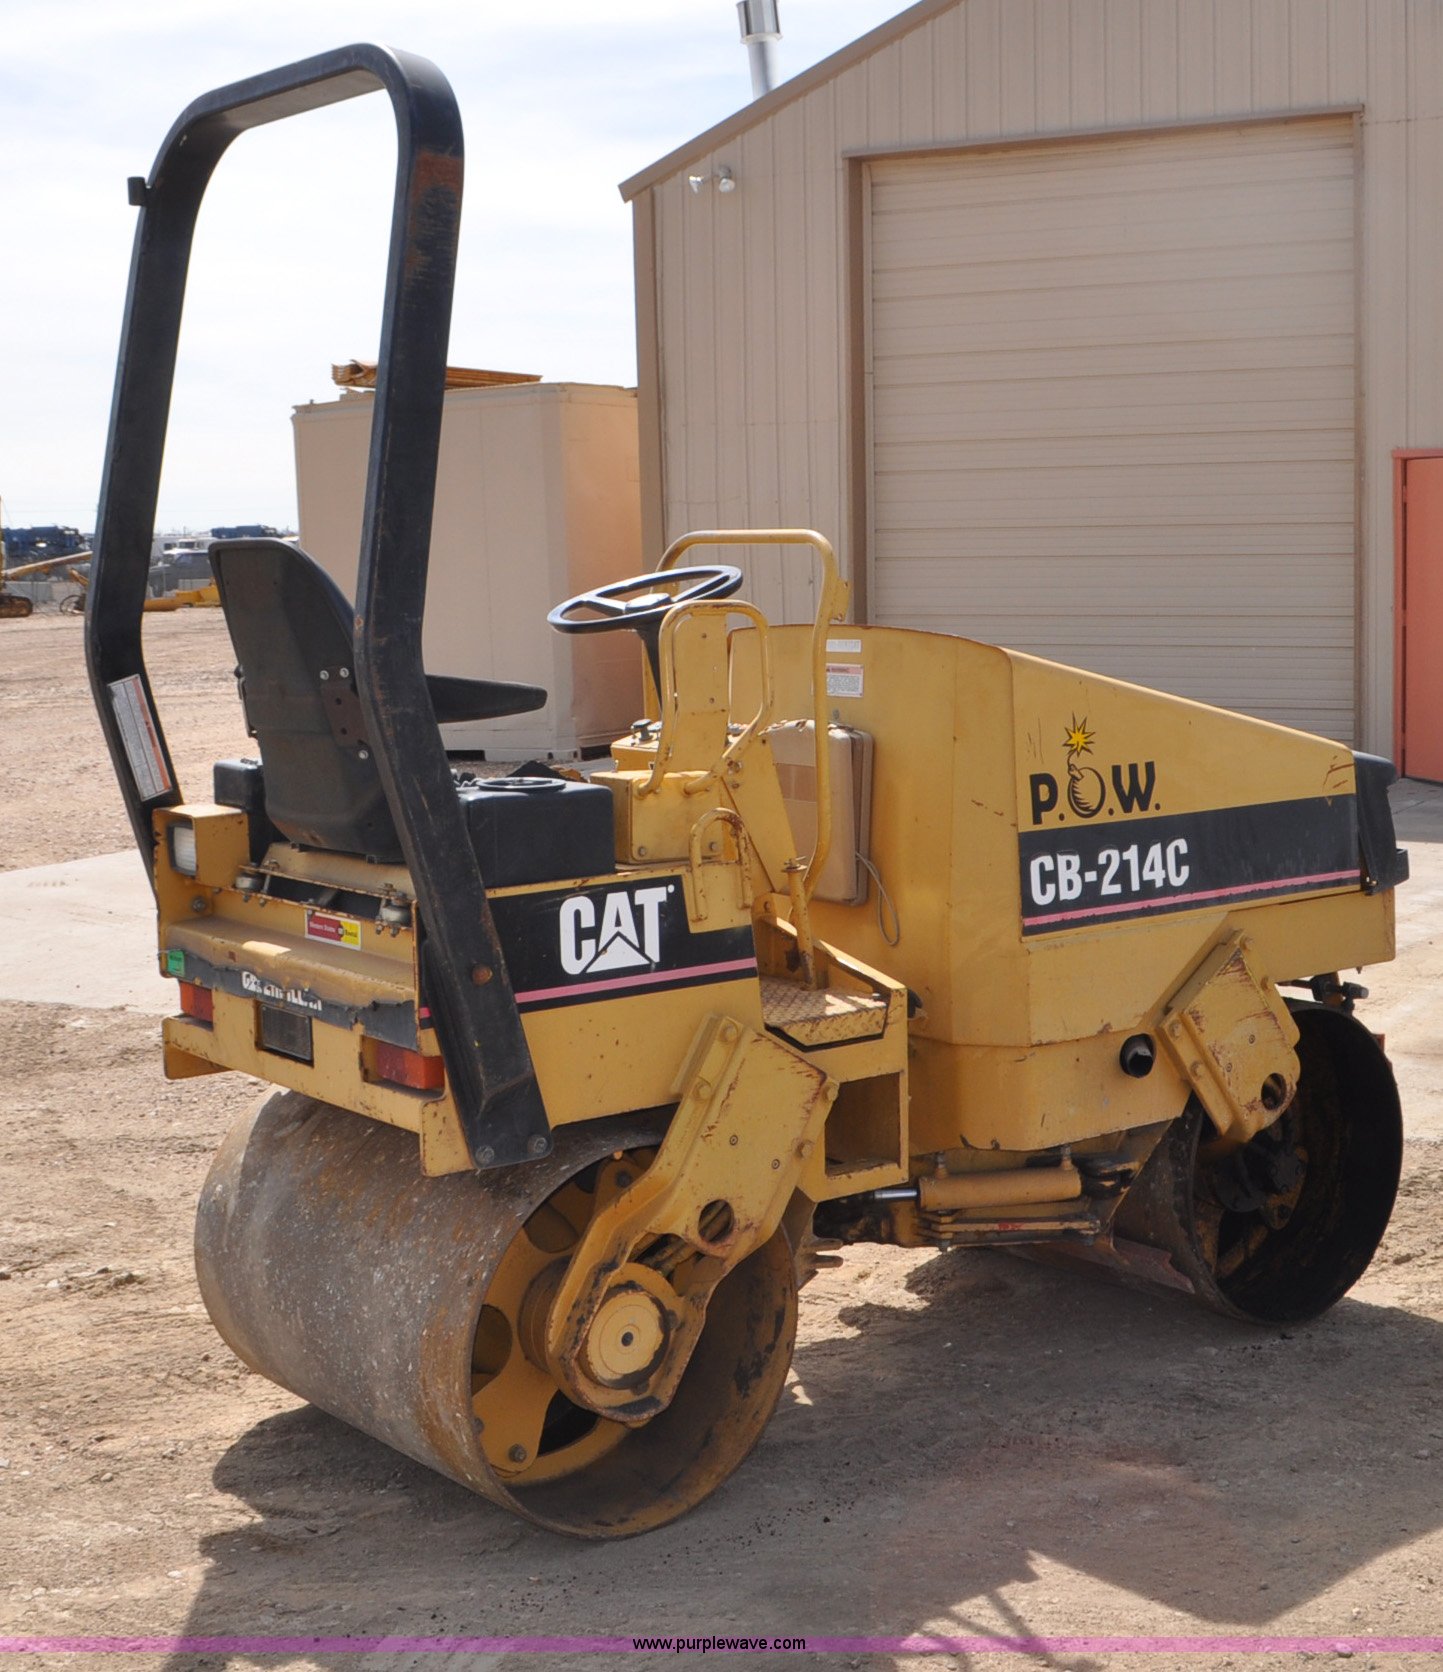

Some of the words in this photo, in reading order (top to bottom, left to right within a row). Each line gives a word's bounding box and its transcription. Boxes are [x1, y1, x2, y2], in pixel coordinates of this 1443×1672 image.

[1029, 761, 1161, 826] P.O.W.
[1029, 838, 1190, 906] CB-214C
[559, 885, 670, 975] CAT
